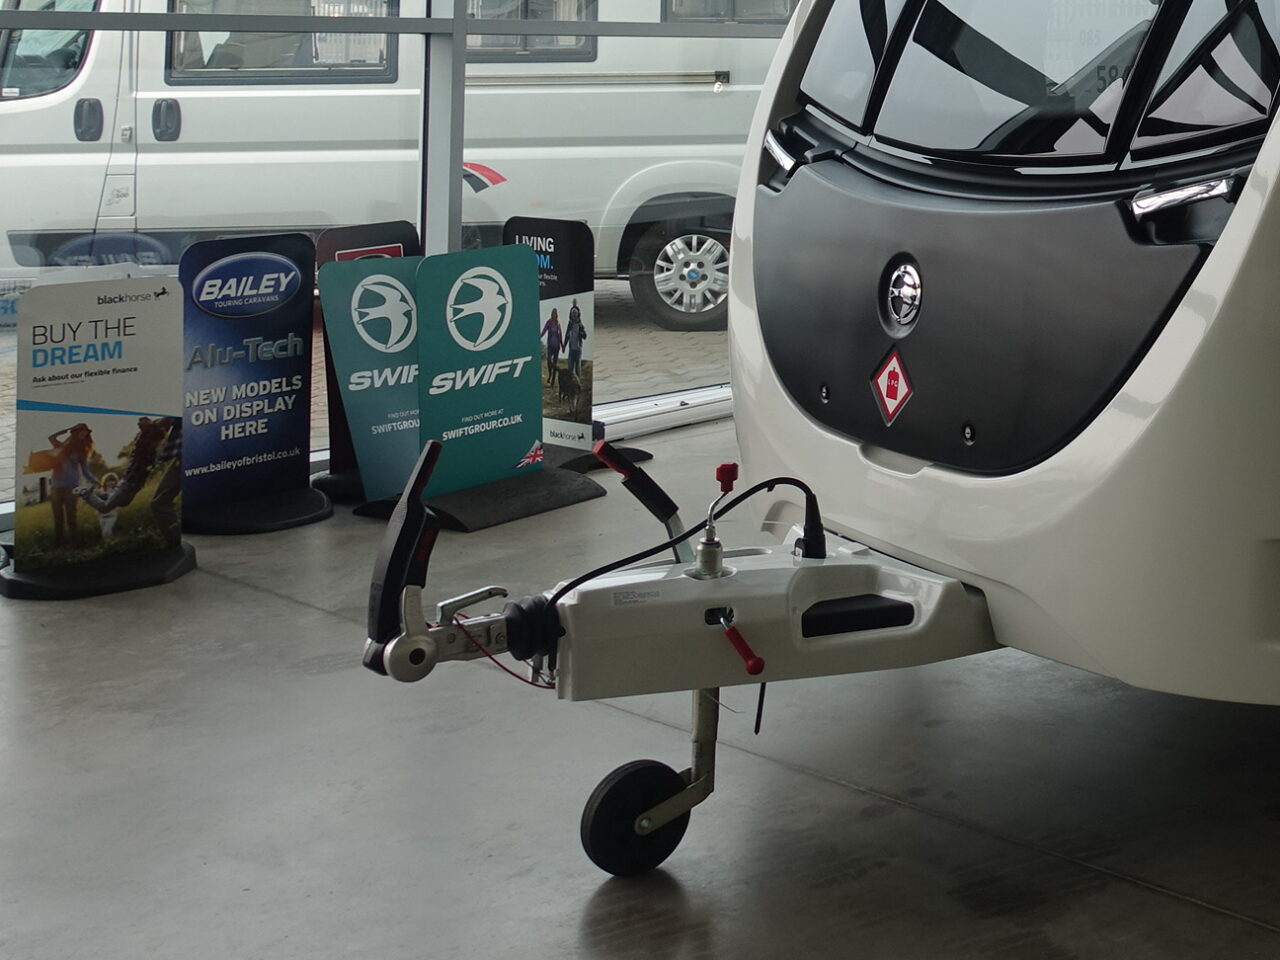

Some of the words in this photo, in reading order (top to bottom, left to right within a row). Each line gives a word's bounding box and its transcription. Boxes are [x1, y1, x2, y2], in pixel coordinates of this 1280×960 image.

[515, 235, 555, 252] LIVING
[97, 292, 151, 305] blackhorse
[198, 271, 297, 301] BAILEY
[214, 299, 243, 308] TOURING
[244, 294, 279, 305] CARAVANS
[32, 321, 83, 346] BUY
[88, 316, 137, 339] THE
[32, 340, 123, 368] DREAM
[185, 332, 304, 371] Alu-Tech
[32, 376, 46, 384] Ask
[48, 373, 69, 382] about
[84, 368, 111, 378] flexible
[112, 367, 138, 375] finance
[348, 364, 419, 391] SWIF
[428, 355, 532, 395] SWIFT
[185, 387, 226, 408] NEW
[232, 375, 302, 400] MODELS
[191, 408, 217, 426] ON
[222, 395, 297, 421] DISPLAY
[473, 413, 484, 421] OUT
[484, 410, 497, 419] MORE
[497, 408, 504, 416] AT
[220, 419, 268, 440] HERE
[371, 418, 421, 435] SWIFTGROU
[442, 413, 523, 441] SWIFTGROUP.CO.UK
[185, 447, 301, 477] www.baileyofbristol.co.uk
